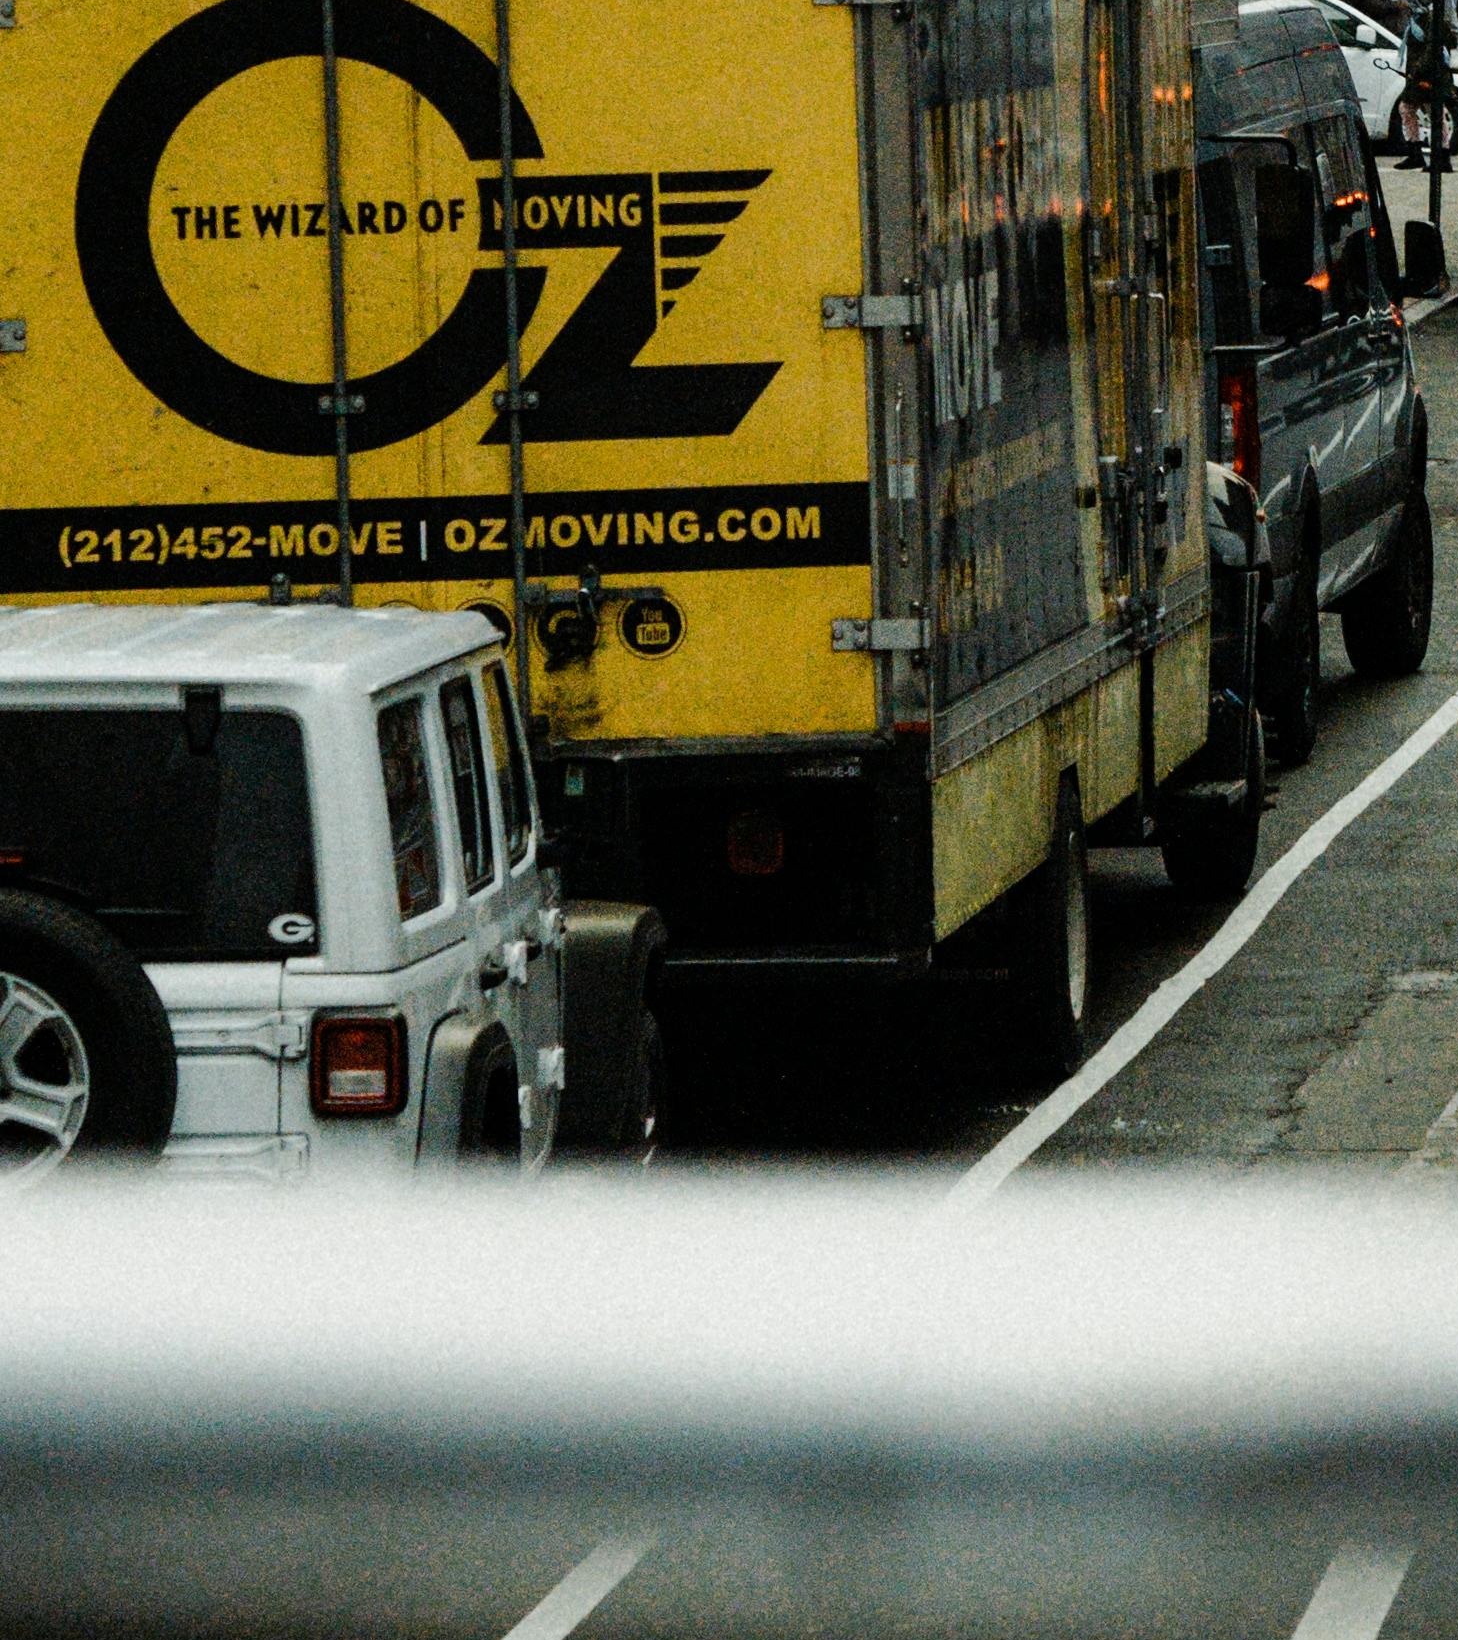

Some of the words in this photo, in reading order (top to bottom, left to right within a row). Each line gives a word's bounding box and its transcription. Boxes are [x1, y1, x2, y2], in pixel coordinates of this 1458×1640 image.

[172, 204, 242, 240] THE
[252, 199, 408, 238] WIZARD
[419, 198, 467, 234] OF
[444, 505, 822, 554] OZMOVING.COM
[641, 608, 662, 623] You
[638, 625, 670, 642] Tube
